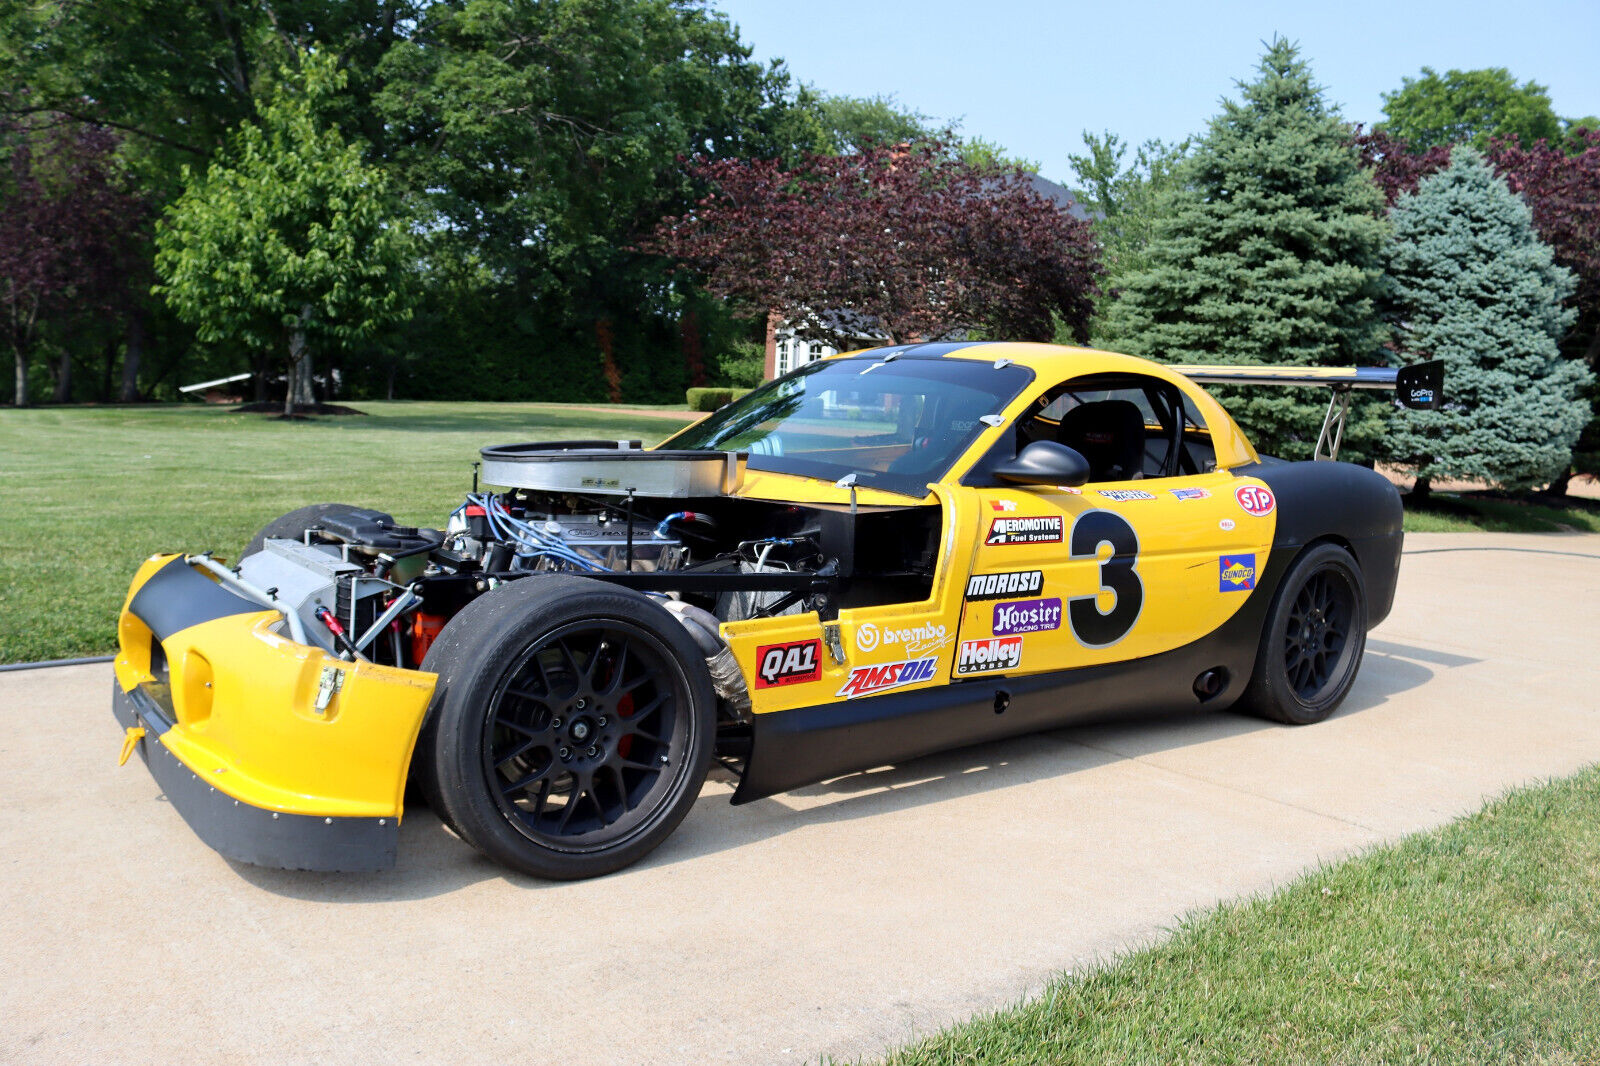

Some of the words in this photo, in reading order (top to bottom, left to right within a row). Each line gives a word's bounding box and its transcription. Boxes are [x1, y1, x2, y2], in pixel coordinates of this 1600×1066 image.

[1411, 389, 1433, 397] GoPro
[1111, 492, 1153, 501] MASTER
[1241, 487, 1270, 511] STP
[988, 518, 1061, 543] AEROMOTIVE
[1029, 533, 1060, 542] Systems
[966, 571, 1042, 596] MOROSO
[1067, 508, 1145, 649] 3
[1223, 569, 1253, 579] SUNOCO
[994, 601, 1060, 632] Hoosier
[883, 621, 946, 645] brembo
[762, 645, 816, 681] QA1
[960, 640, 1021, 667] Holley
[842, 658, 937, 696] AMSOIL
[959, 661, 1004, 673] CARBS
